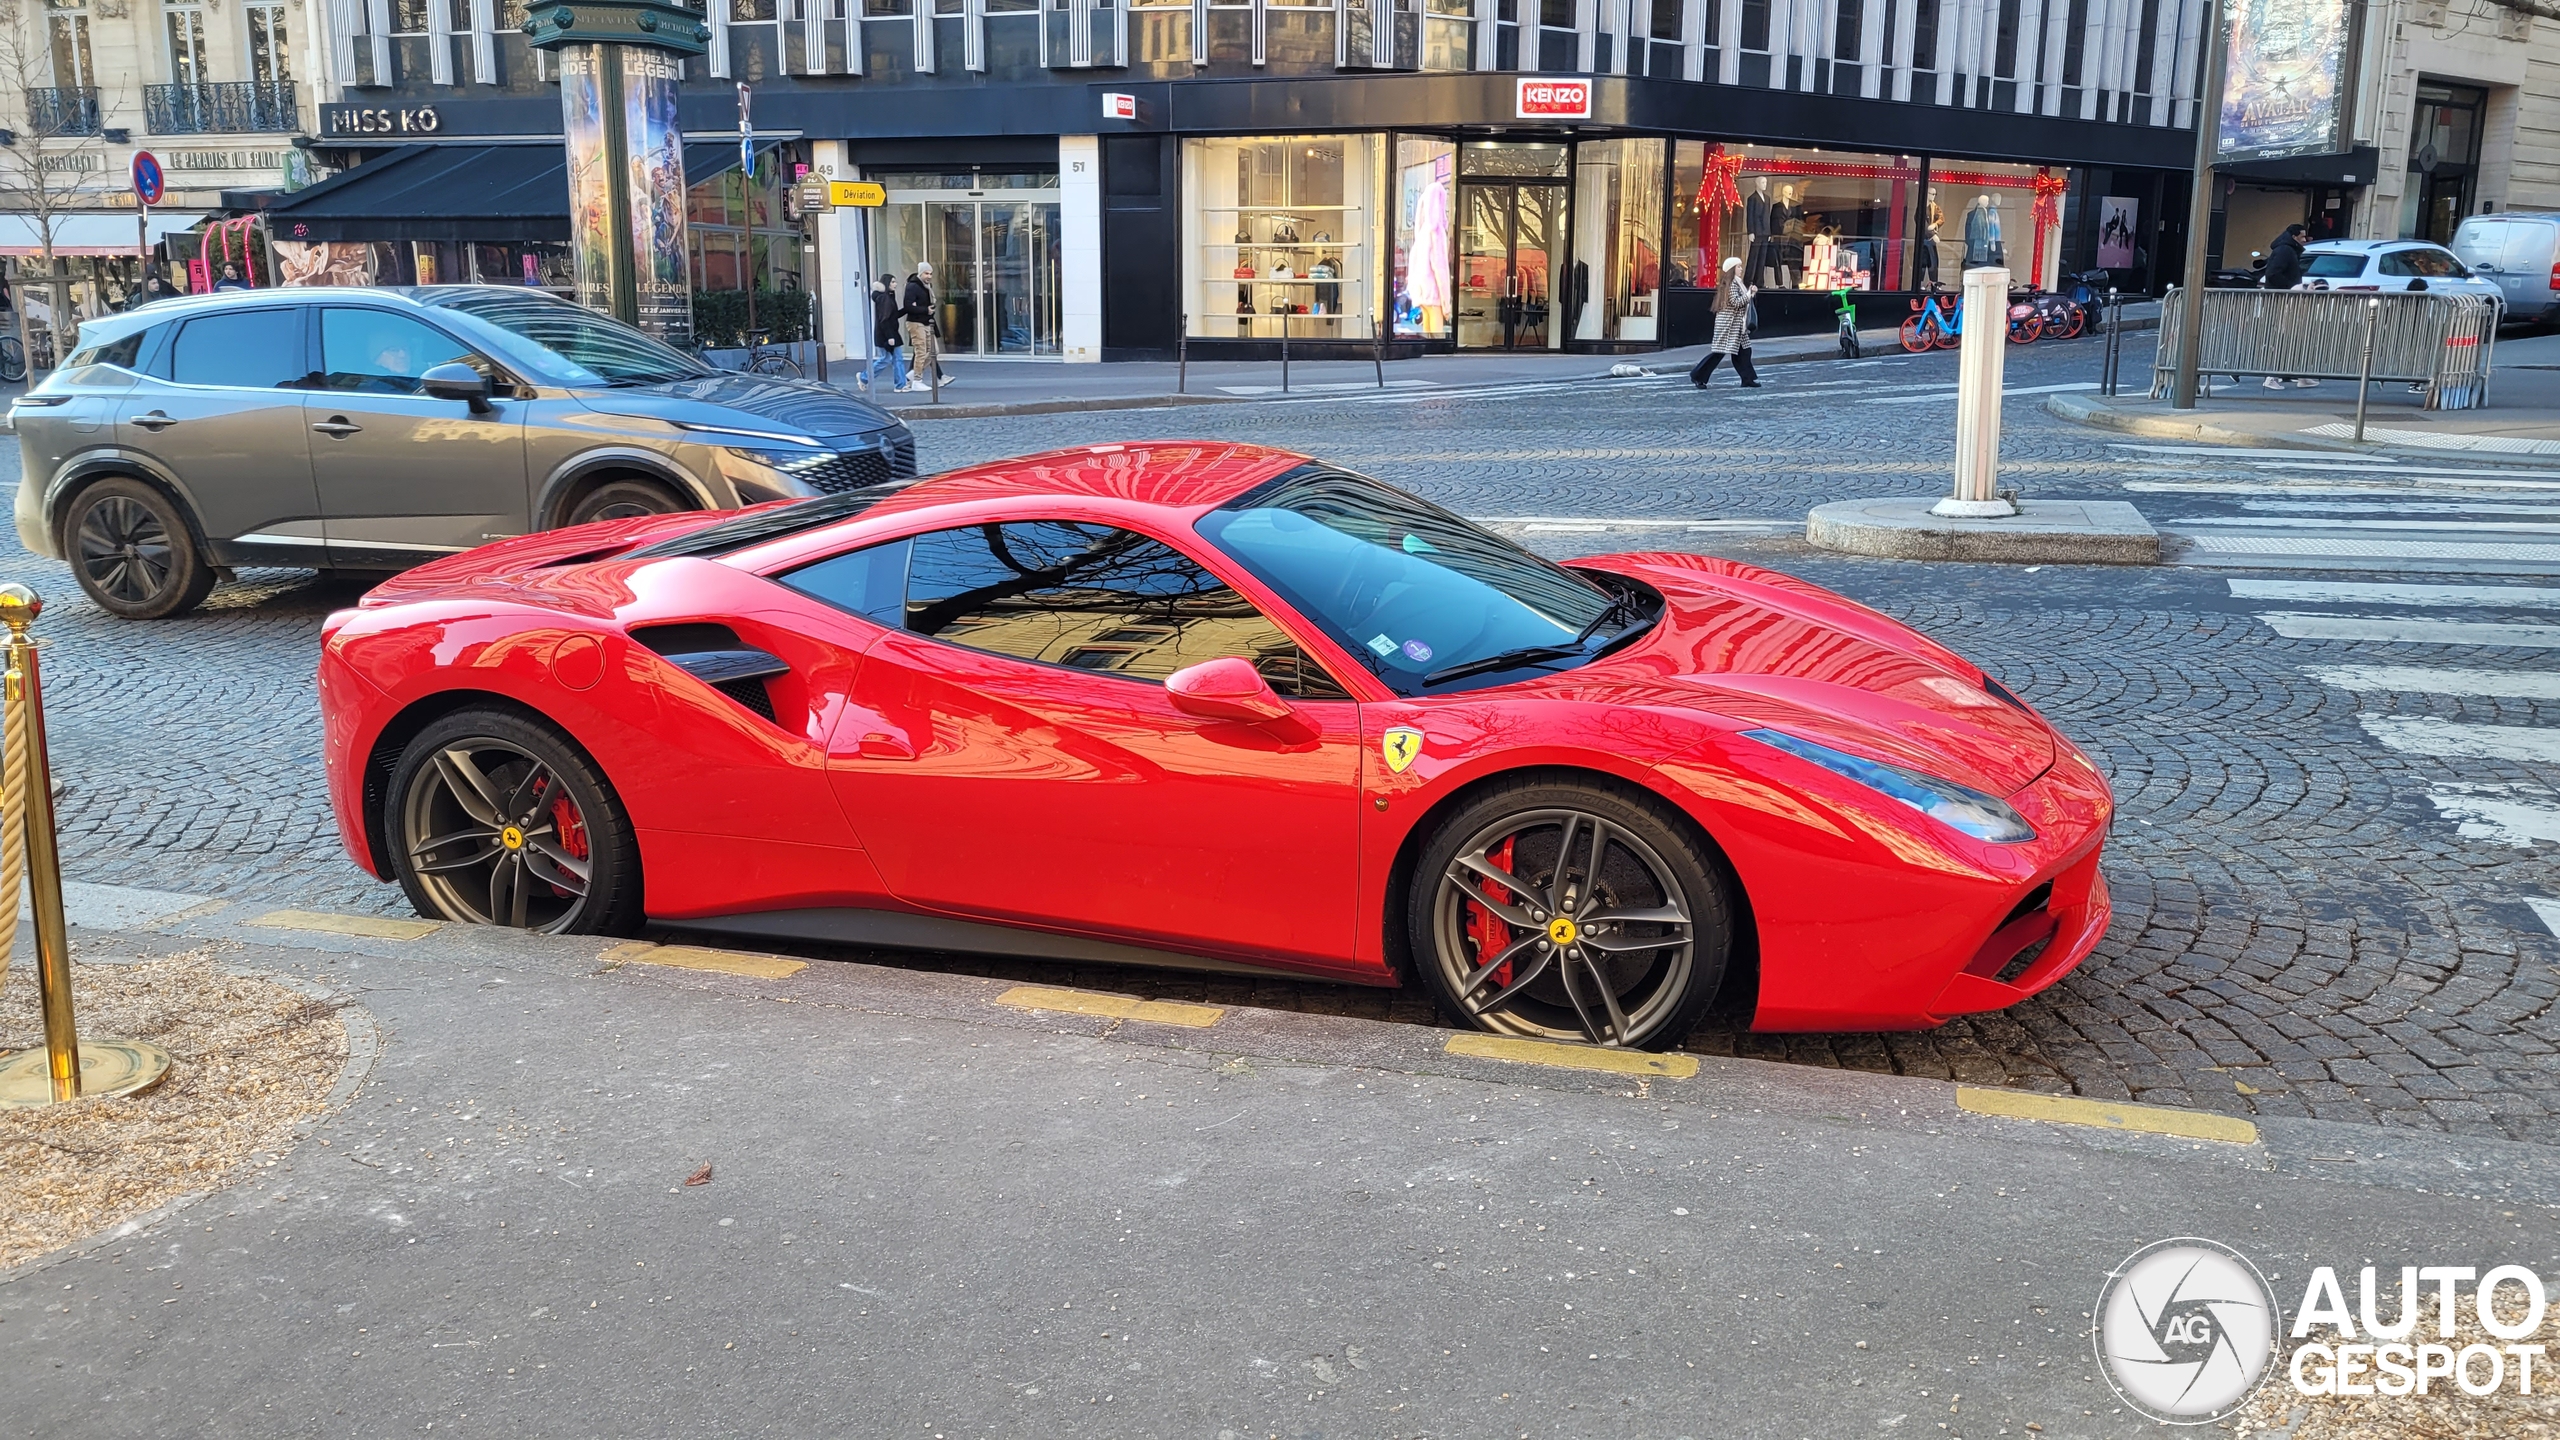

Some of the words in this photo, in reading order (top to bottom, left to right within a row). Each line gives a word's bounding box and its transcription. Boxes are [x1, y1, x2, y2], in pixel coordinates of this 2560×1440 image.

[575, 15, 636, 26] SPECTACLES
[623, 52, 662, 64] ENTREZ
[1526, 87, 1584, 104] KENZO
[2241, 98, 2313, 121] AVATAR
[184, 152, 226, 169] PARADIS
[230, 151, 245, 168] DU
[249, 151, 278, 168] FRUIT
[819, 164, 834, 176] 49
[1072, 161, 1085, 173] 51
[843, 188, 876, 200] Déviation
